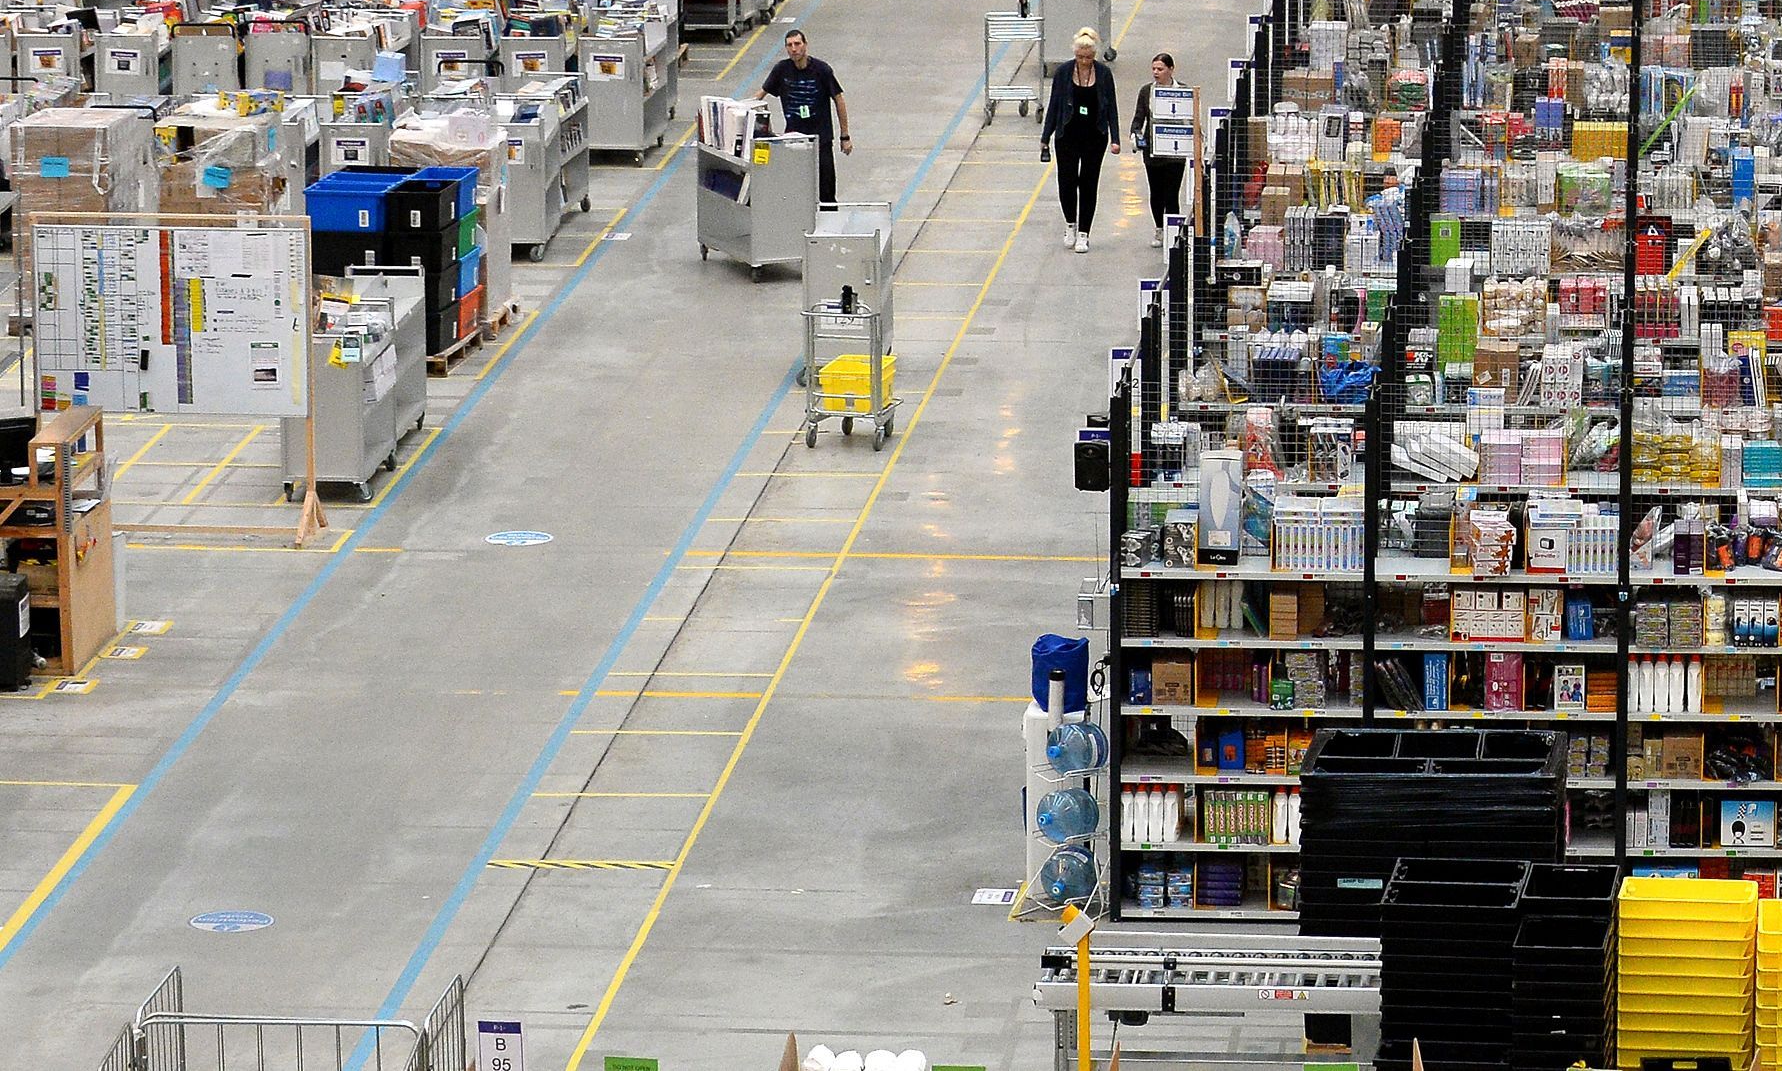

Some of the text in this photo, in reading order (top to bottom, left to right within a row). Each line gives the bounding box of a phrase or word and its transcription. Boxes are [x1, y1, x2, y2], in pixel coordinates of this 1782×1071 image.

[1158, 90, 1181, 98] Damage
[495, 1037, 507, 1051] B
[491, 1058, 512, 1071] 95
